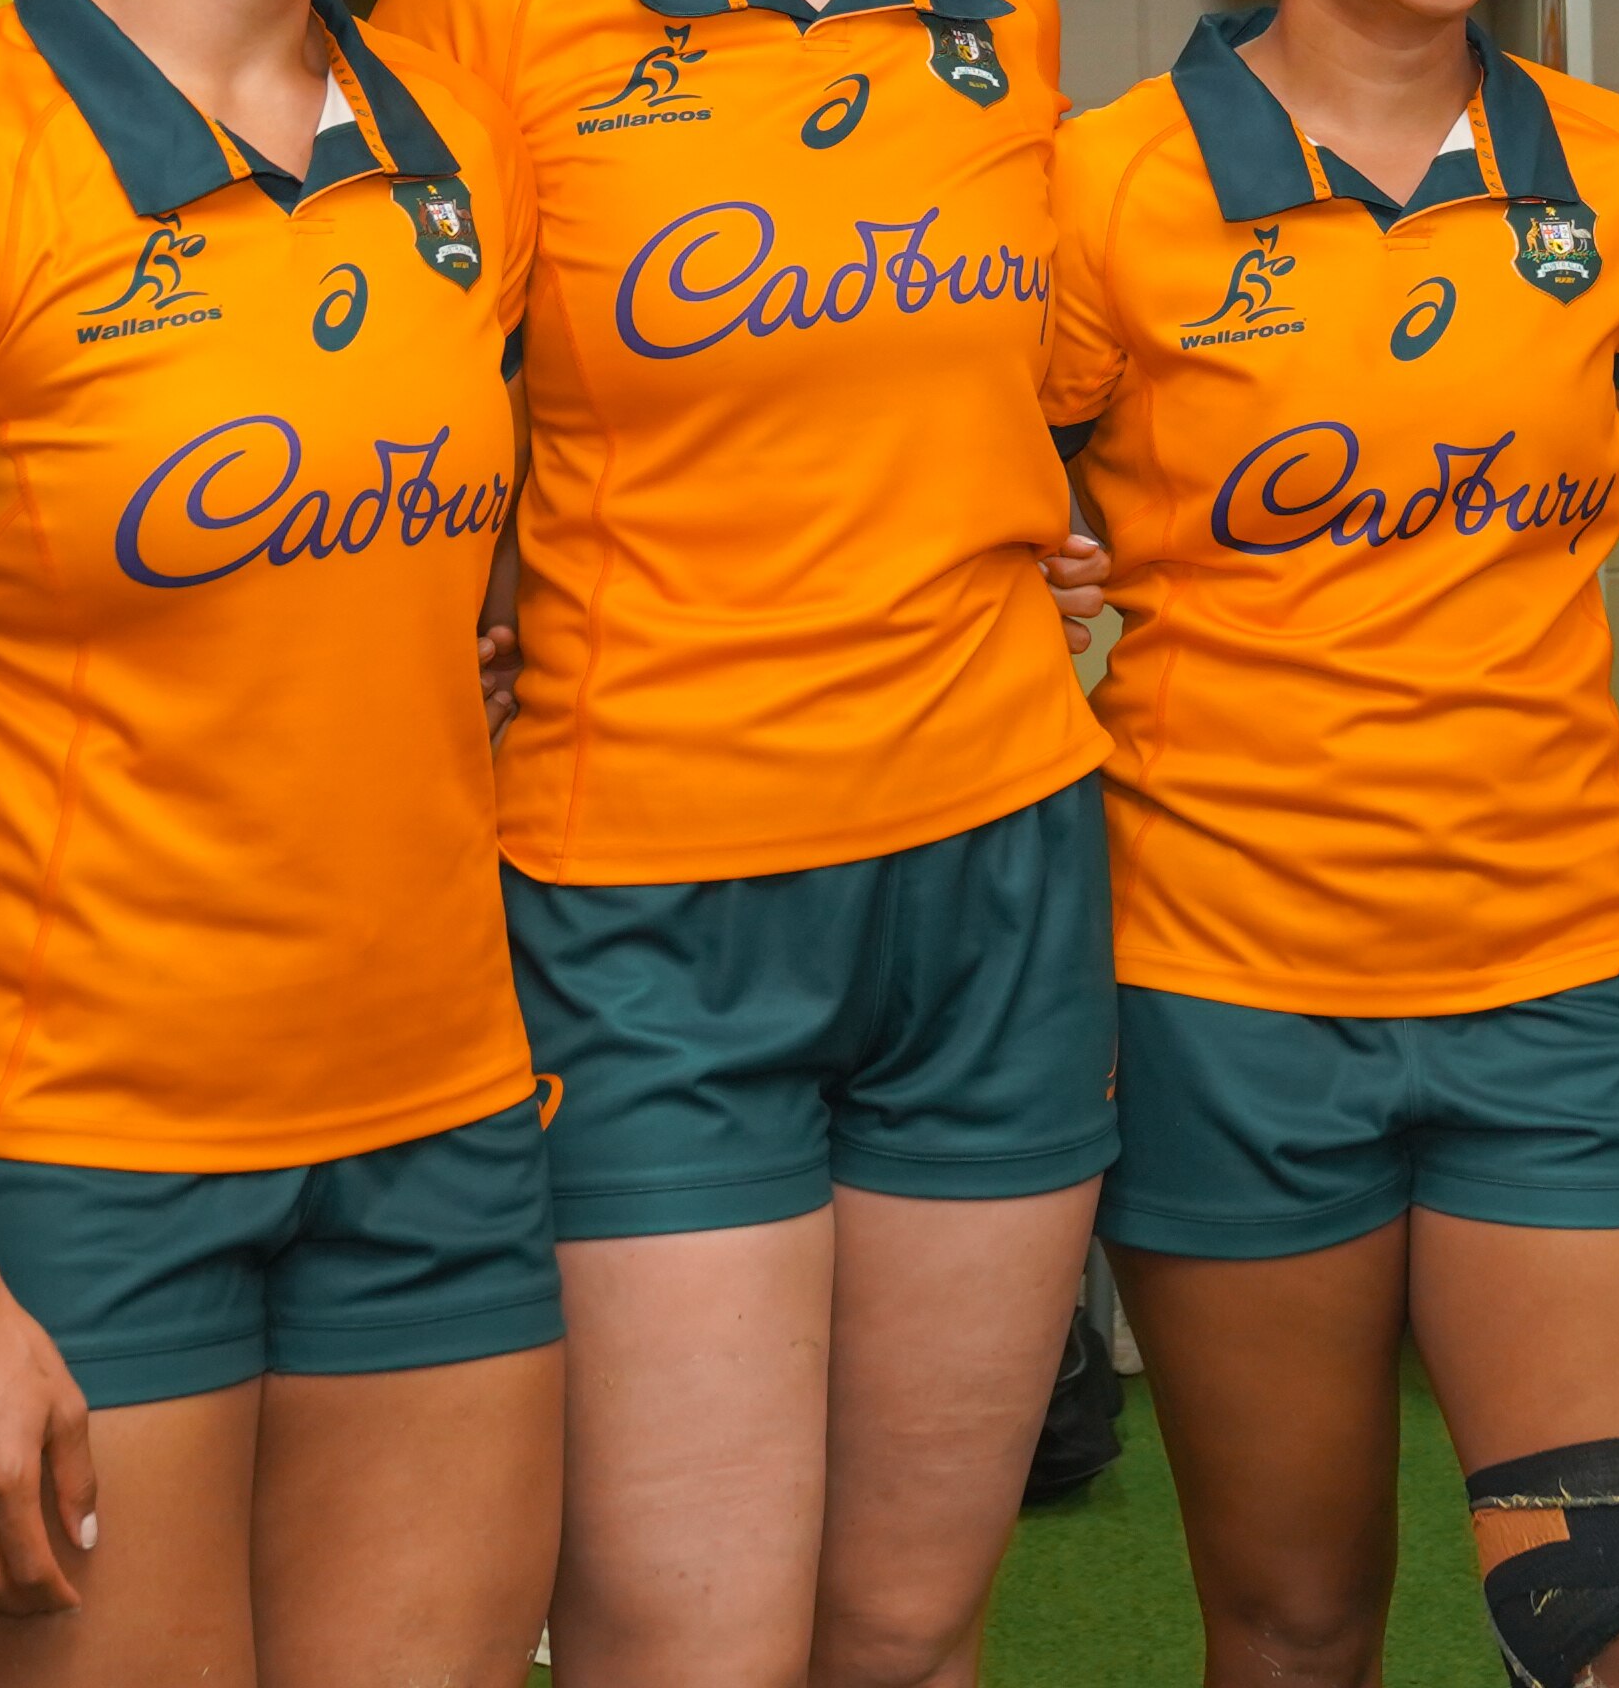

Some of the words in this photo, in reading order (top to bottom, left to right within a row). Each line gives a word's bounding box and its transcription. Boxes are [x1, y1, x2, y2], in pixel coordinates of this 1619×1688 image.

[577, 109, 712, 136] Wallaroos
[615, 201, 1049, 359] Cadbury
[77, 306, 222, 344] Wallaroos
[1180, 320, 1306, 350] Wallaroos
[115, 415, 510, 589] Cadbur
[1211, 421, 1616, 555] Cadbury
